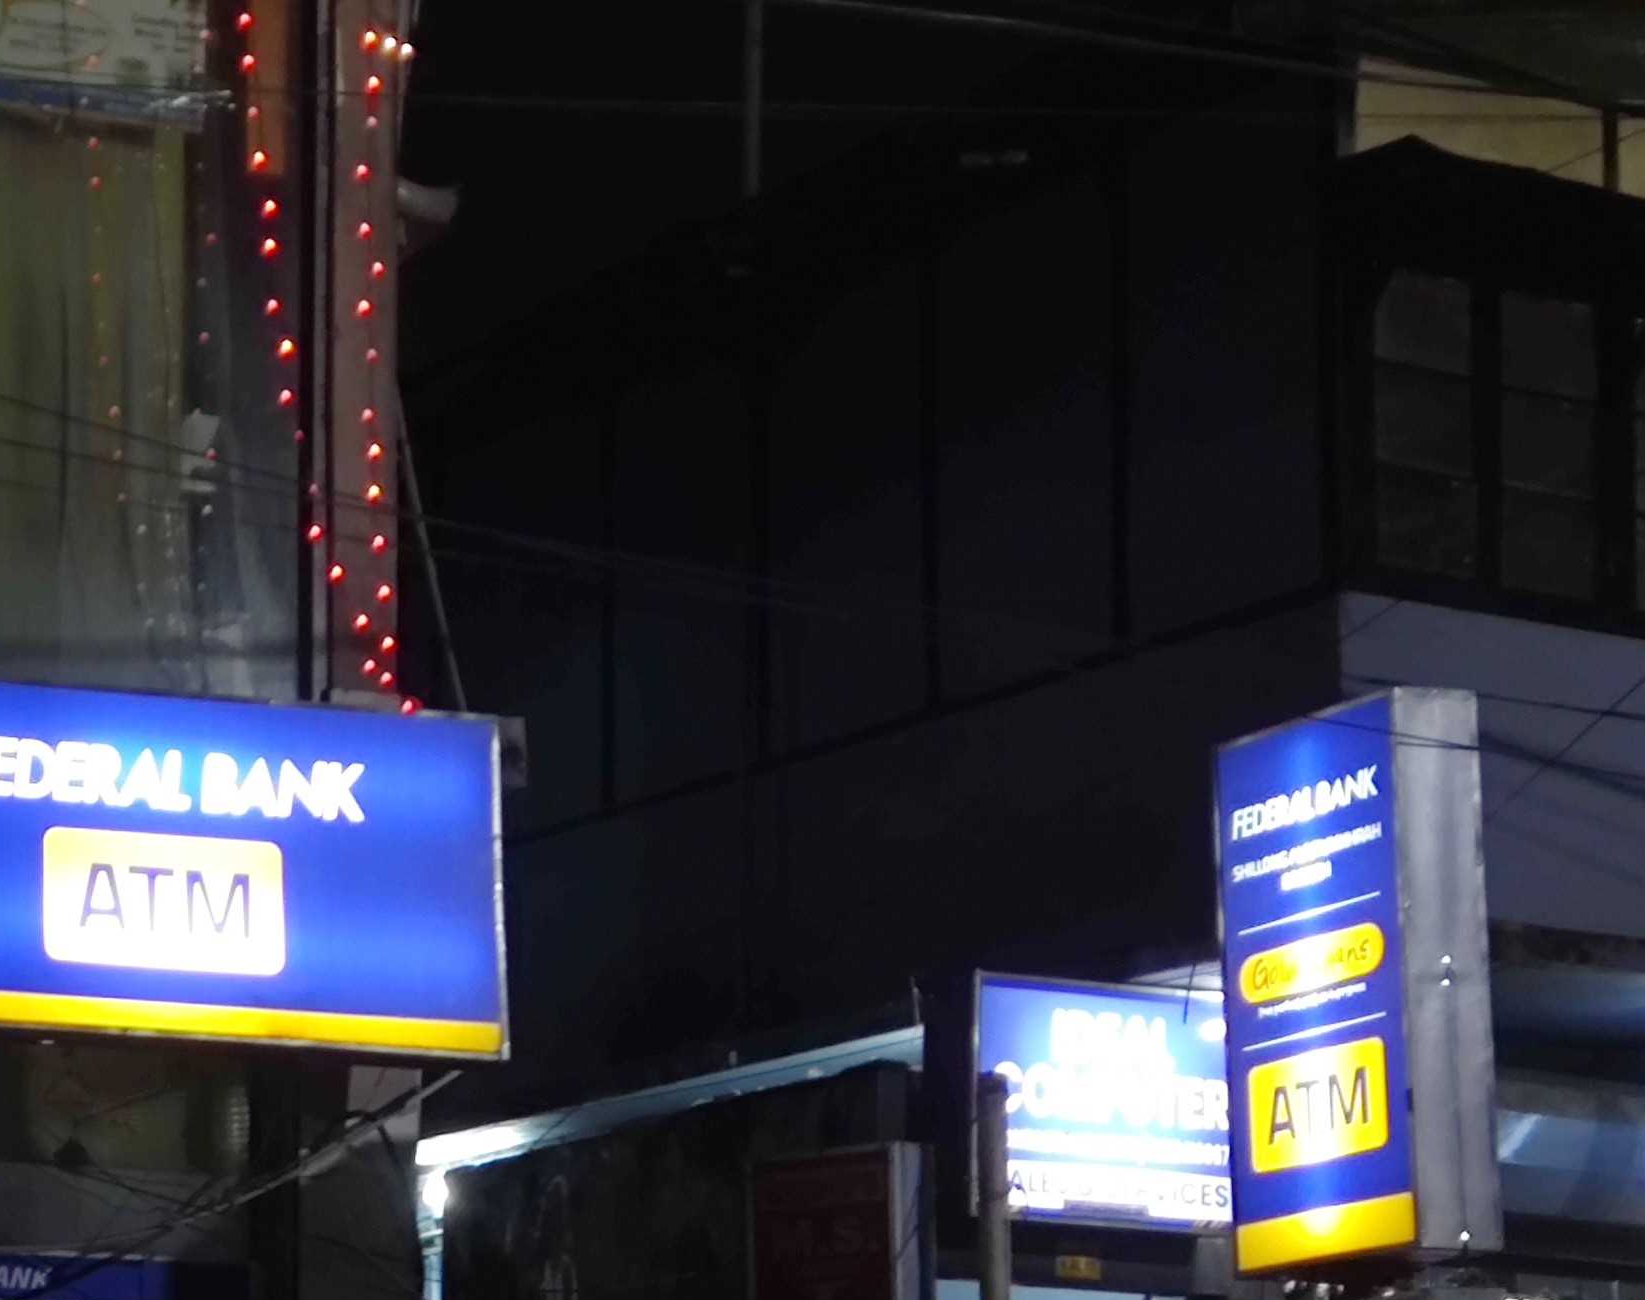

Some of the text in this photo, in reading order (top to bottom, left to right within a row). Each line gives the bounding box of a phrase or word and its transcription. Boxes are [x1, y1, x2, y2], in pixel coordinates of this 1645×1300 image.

[200, 751, 365, 824] BANK
[1231, 764, 1379, 841] FEDERAL BANK
[79, 861, 251, 939] ATM
[1267, 1066, 1370, 1147] ATM
